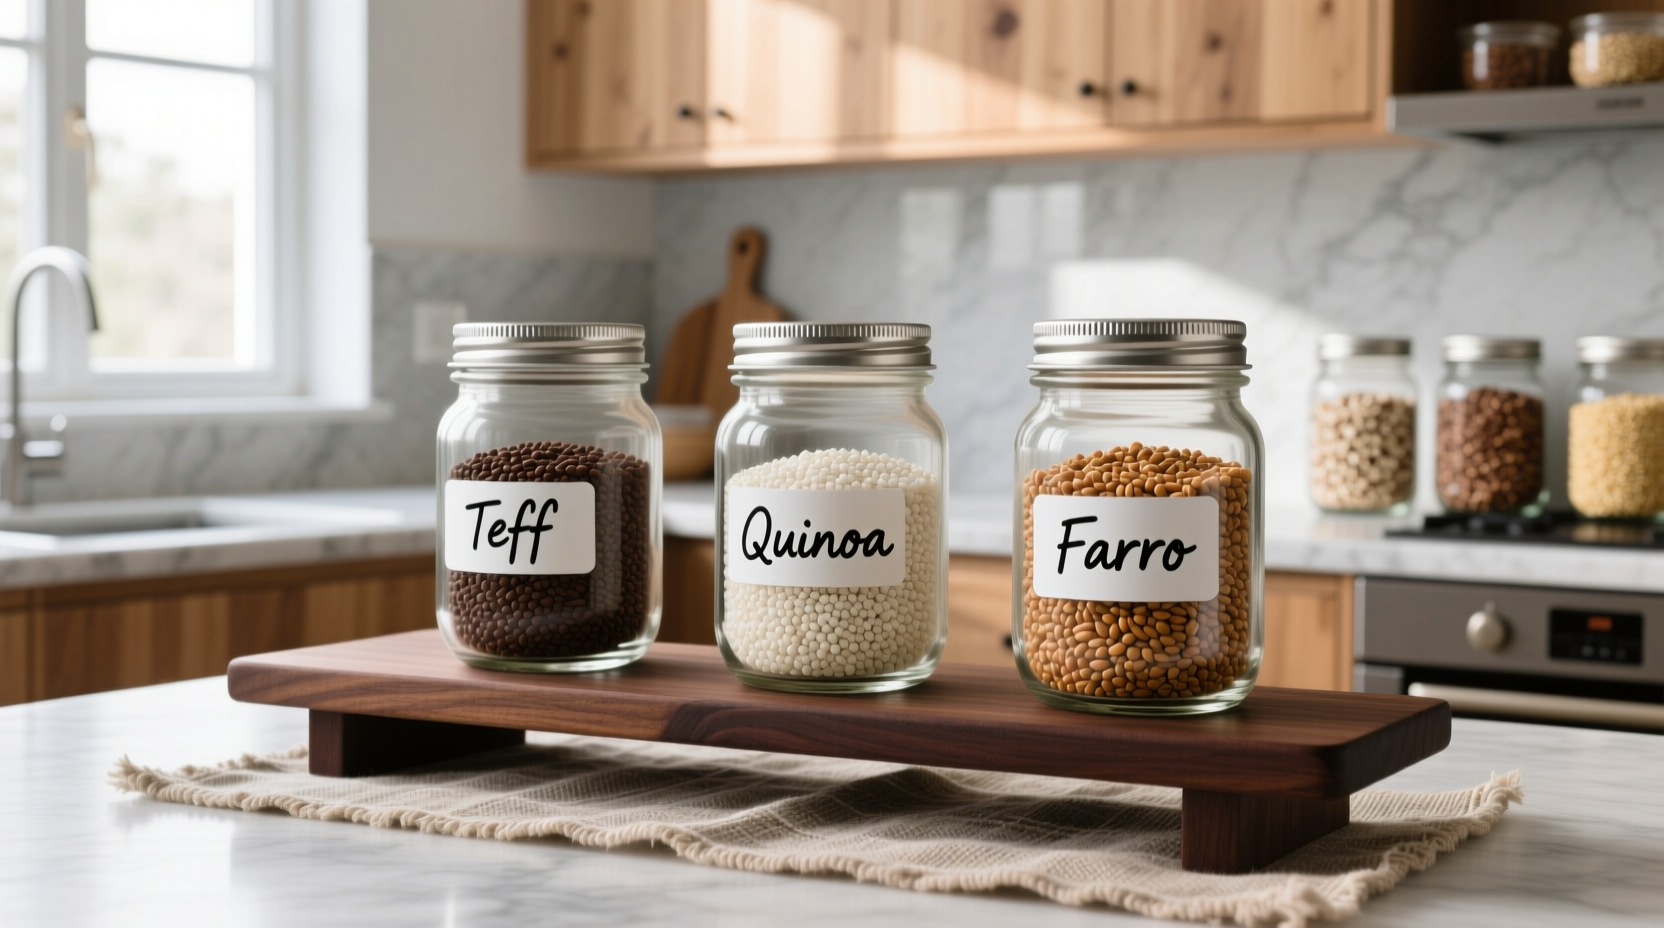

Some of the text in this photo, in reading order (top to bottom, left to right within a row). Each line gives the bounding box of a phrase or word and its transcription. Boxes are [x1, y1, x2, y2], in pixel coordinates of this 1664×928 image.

[465, 497, 559, 565] Teff
[741, 505, 894, 566] Quinoa
[1056, 515, 1197, 575] Farro
